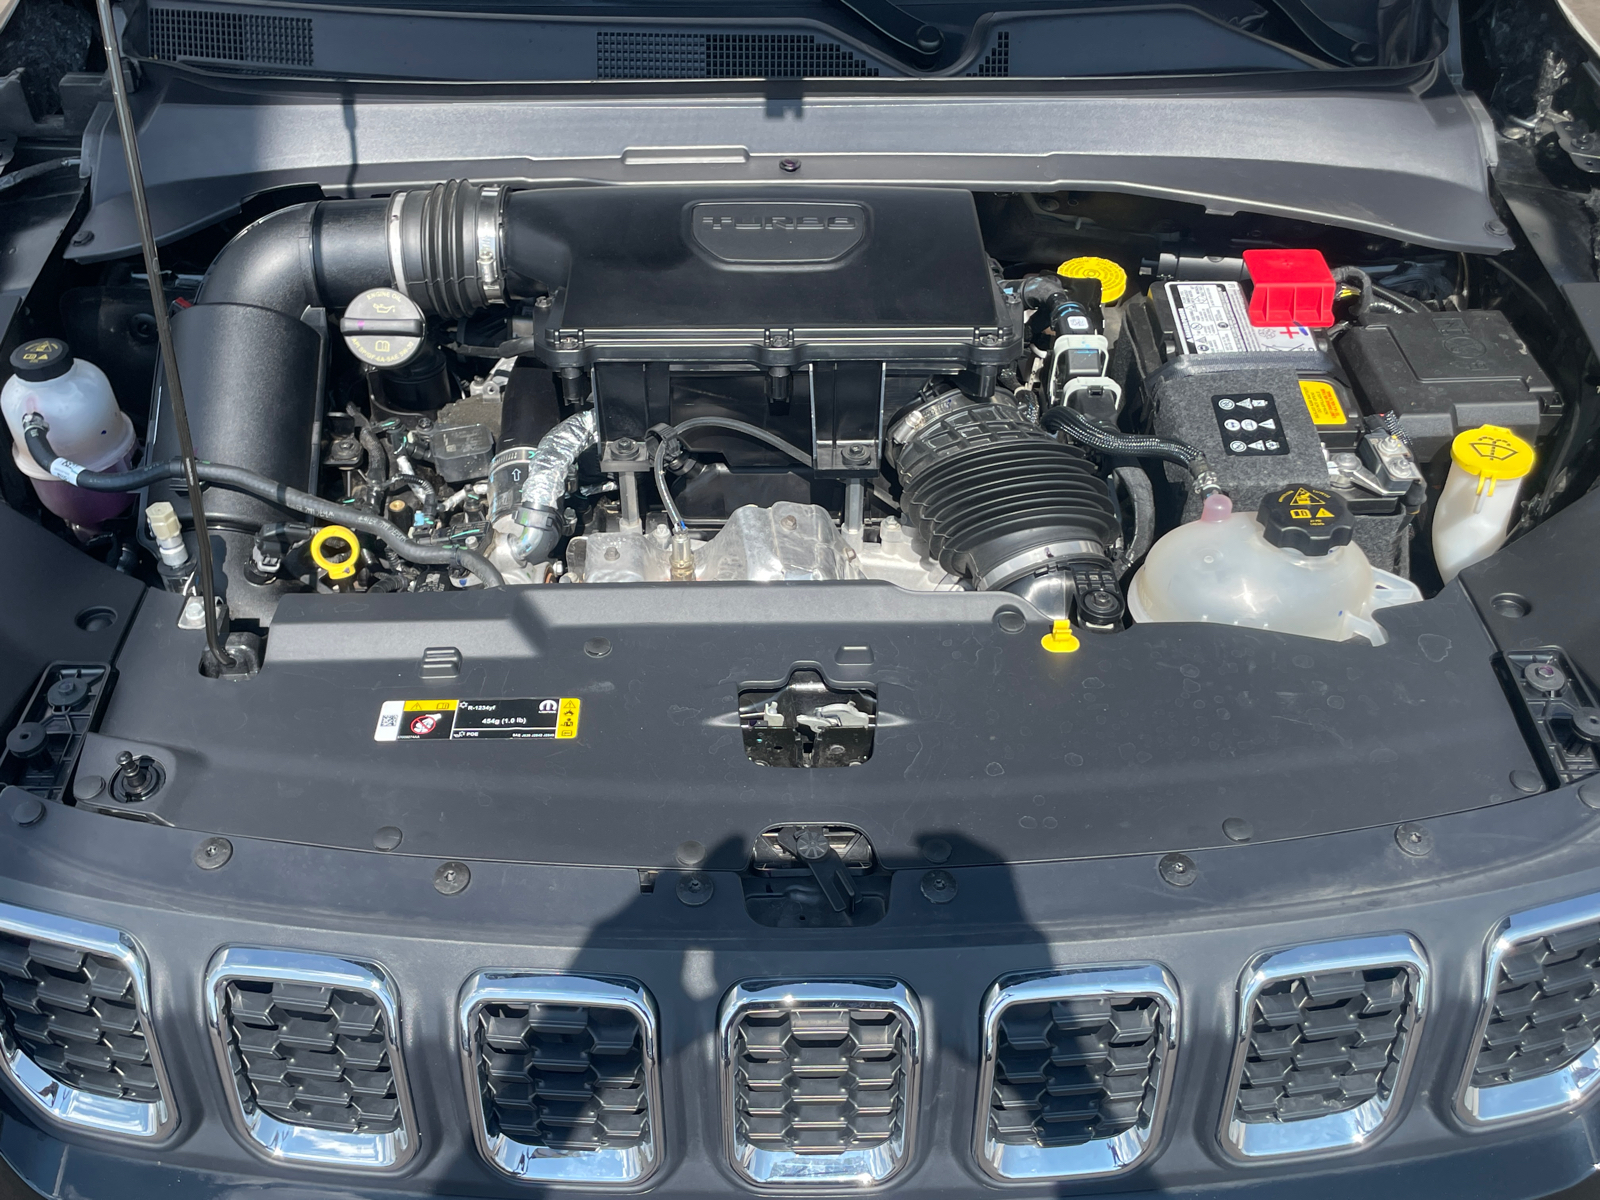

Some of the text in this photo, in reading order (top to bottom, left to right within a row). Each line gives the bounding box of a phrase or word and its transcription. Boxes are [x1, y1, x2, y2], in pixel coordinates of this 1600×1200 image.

[702, 216, 856, 230] TURBO
[366, 291, 402, 303] ENGINE OIL
